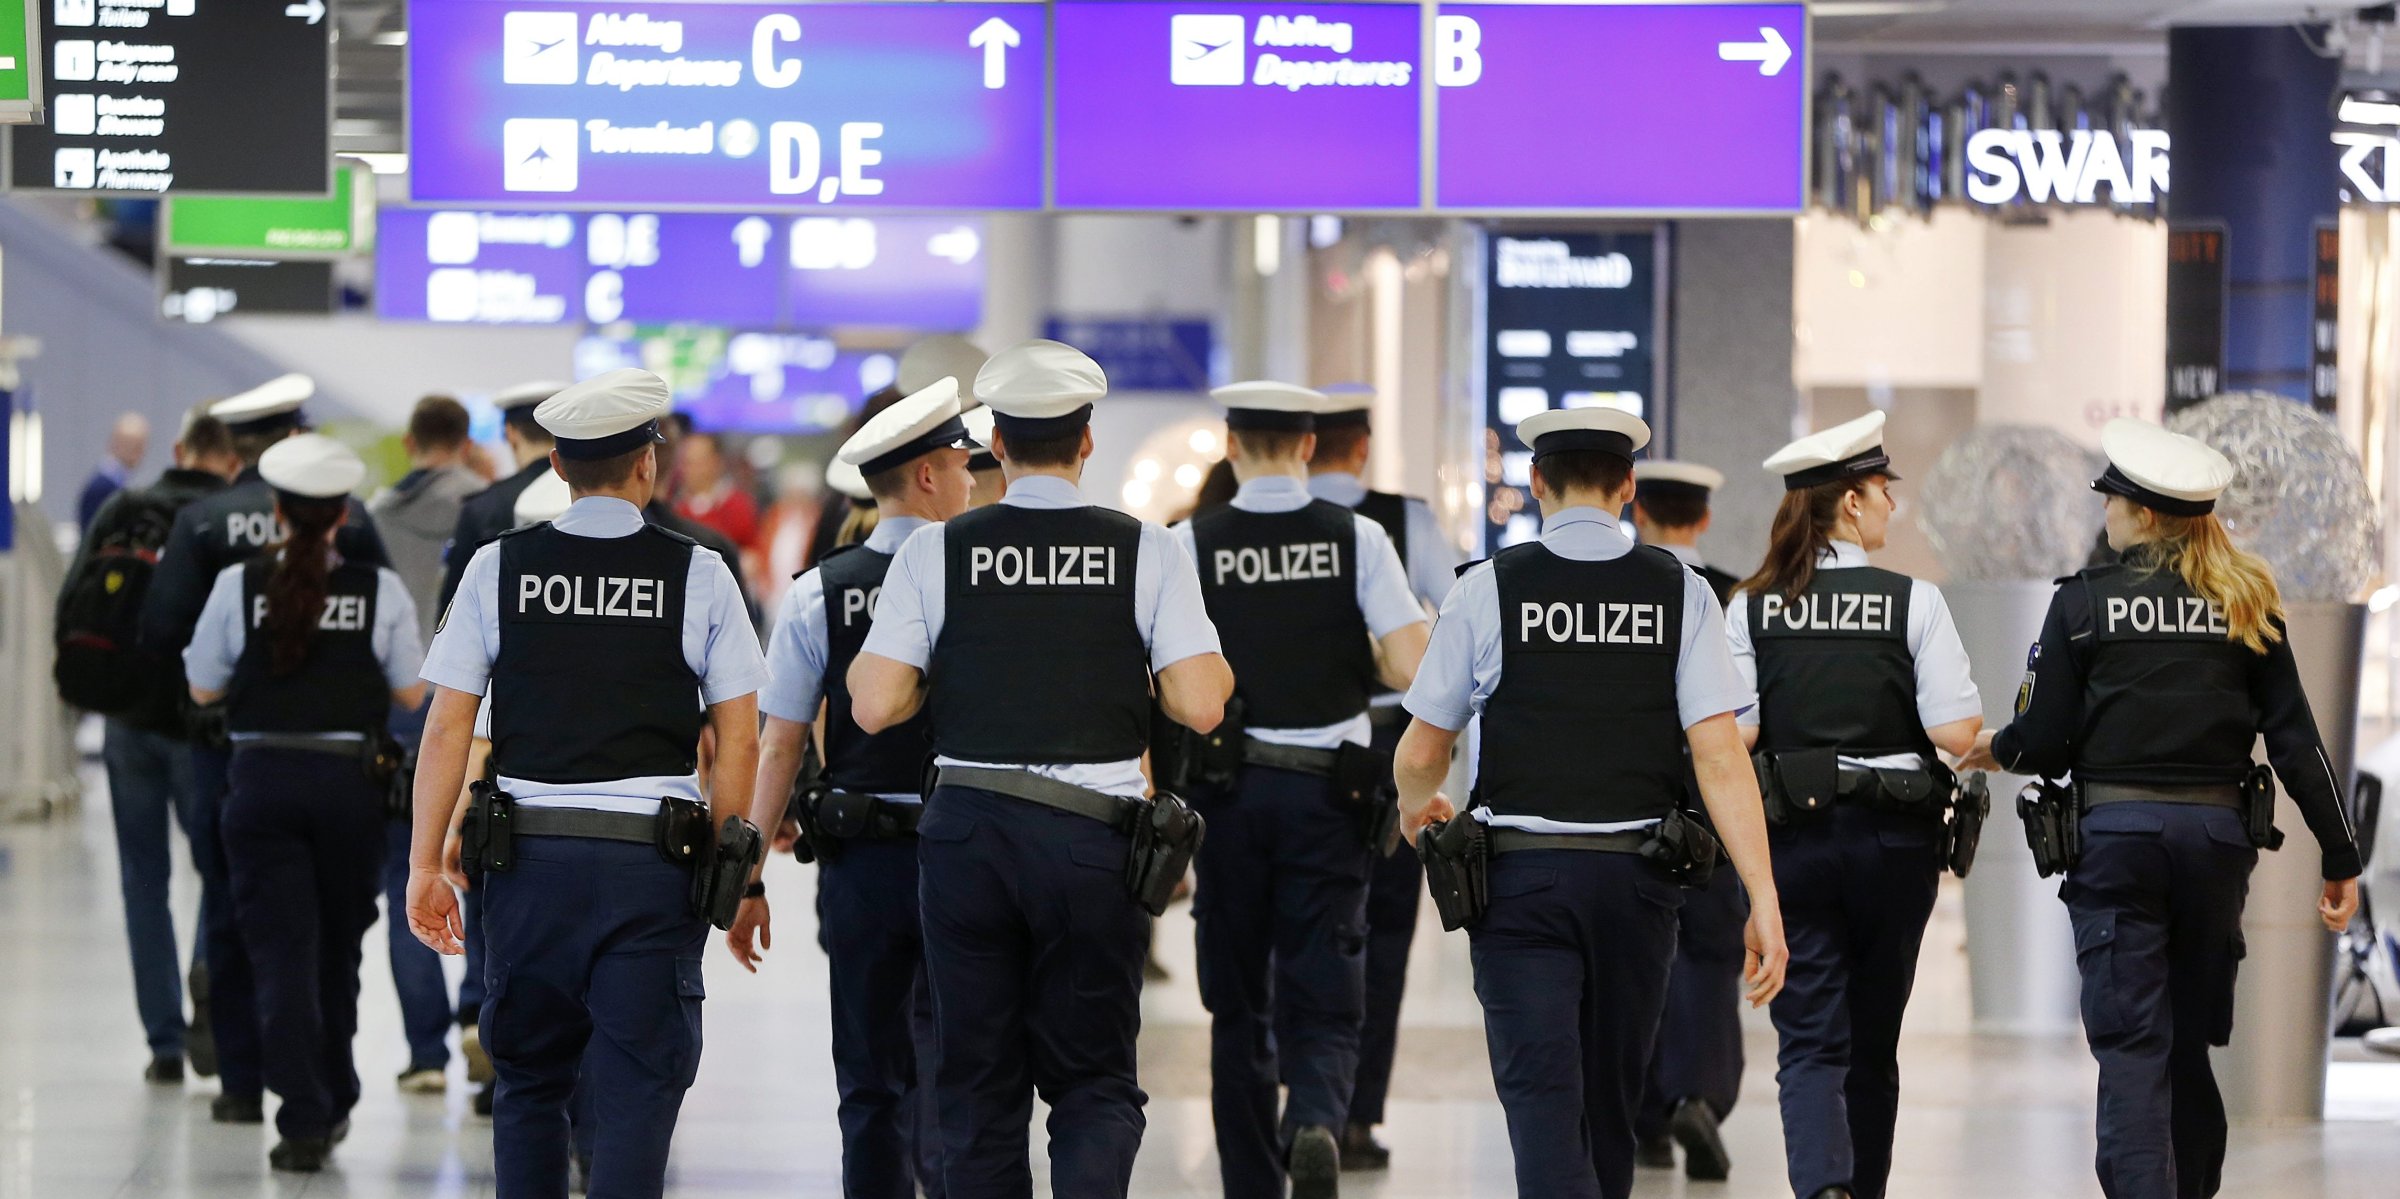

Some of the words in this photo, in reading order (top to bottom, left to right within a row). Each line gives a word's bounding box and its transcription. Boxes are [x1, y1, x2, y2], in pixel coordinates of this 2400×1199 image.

[584, 12, 683, 53] Abflug
[752, 13, 802, 88] C
[1253, 14, 1353, 54] Abflug
[1435, 15, 1482, 87] B
[585, 51, 742, 92] Departures
[1252, 53, 1413, 92] Departures
[584, 119, 714, 154] Terminal
[769, 121, 884, 203] D,E
[1967, 127, 2171, 204] SWAR
[227, 513, 288, 546] POL
[971, 546, 1116, 586] POLIZEI
[1215, 542, 1341, 585] POLIZEI
[519, 574, 664, 618] POLIZEI
[1762, 593, 1892, 631] POLIZEI
[2107, 596, 2228, 634] POLIZE
[1521, 602, 1664, 644] POLIZEI
